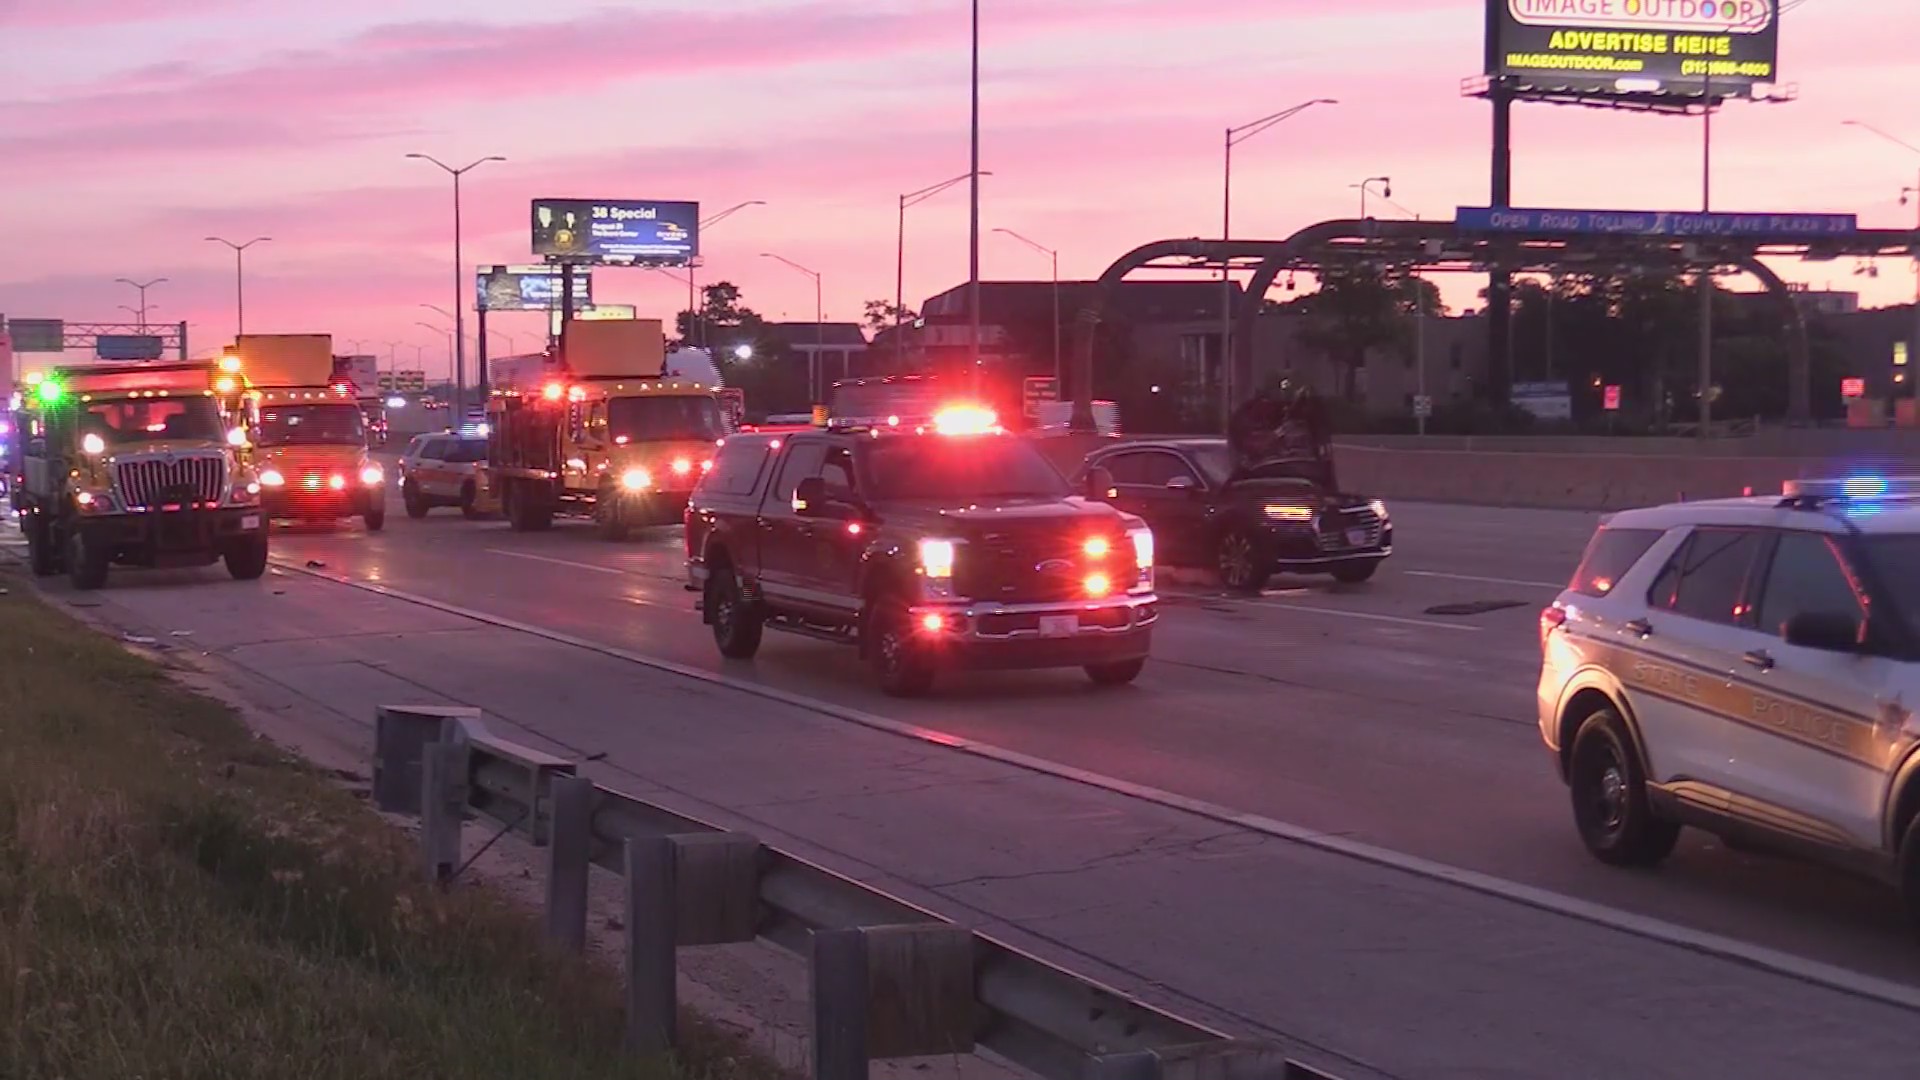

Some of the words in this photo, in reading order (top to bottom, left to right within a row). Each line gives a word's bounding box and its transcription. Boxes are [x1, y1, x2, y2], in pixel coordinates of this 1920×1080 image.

[1525, 0, 1613, 15] IMAGE
[1623, 0, 1753, 21] OUTDOOR
[1548, 30, 1668, 53] ADVERTISE
[1673, 35, 1731, 55] HERE
[1506, 53, 1644, 71] IMAGEOUTDOOR.com
[592, 206, 608, 218] 38
[610, 207, 657, 221] Special
[1634, 659, 1699, 698] STATE
[1752, 696, 1848, 745] POLICE
